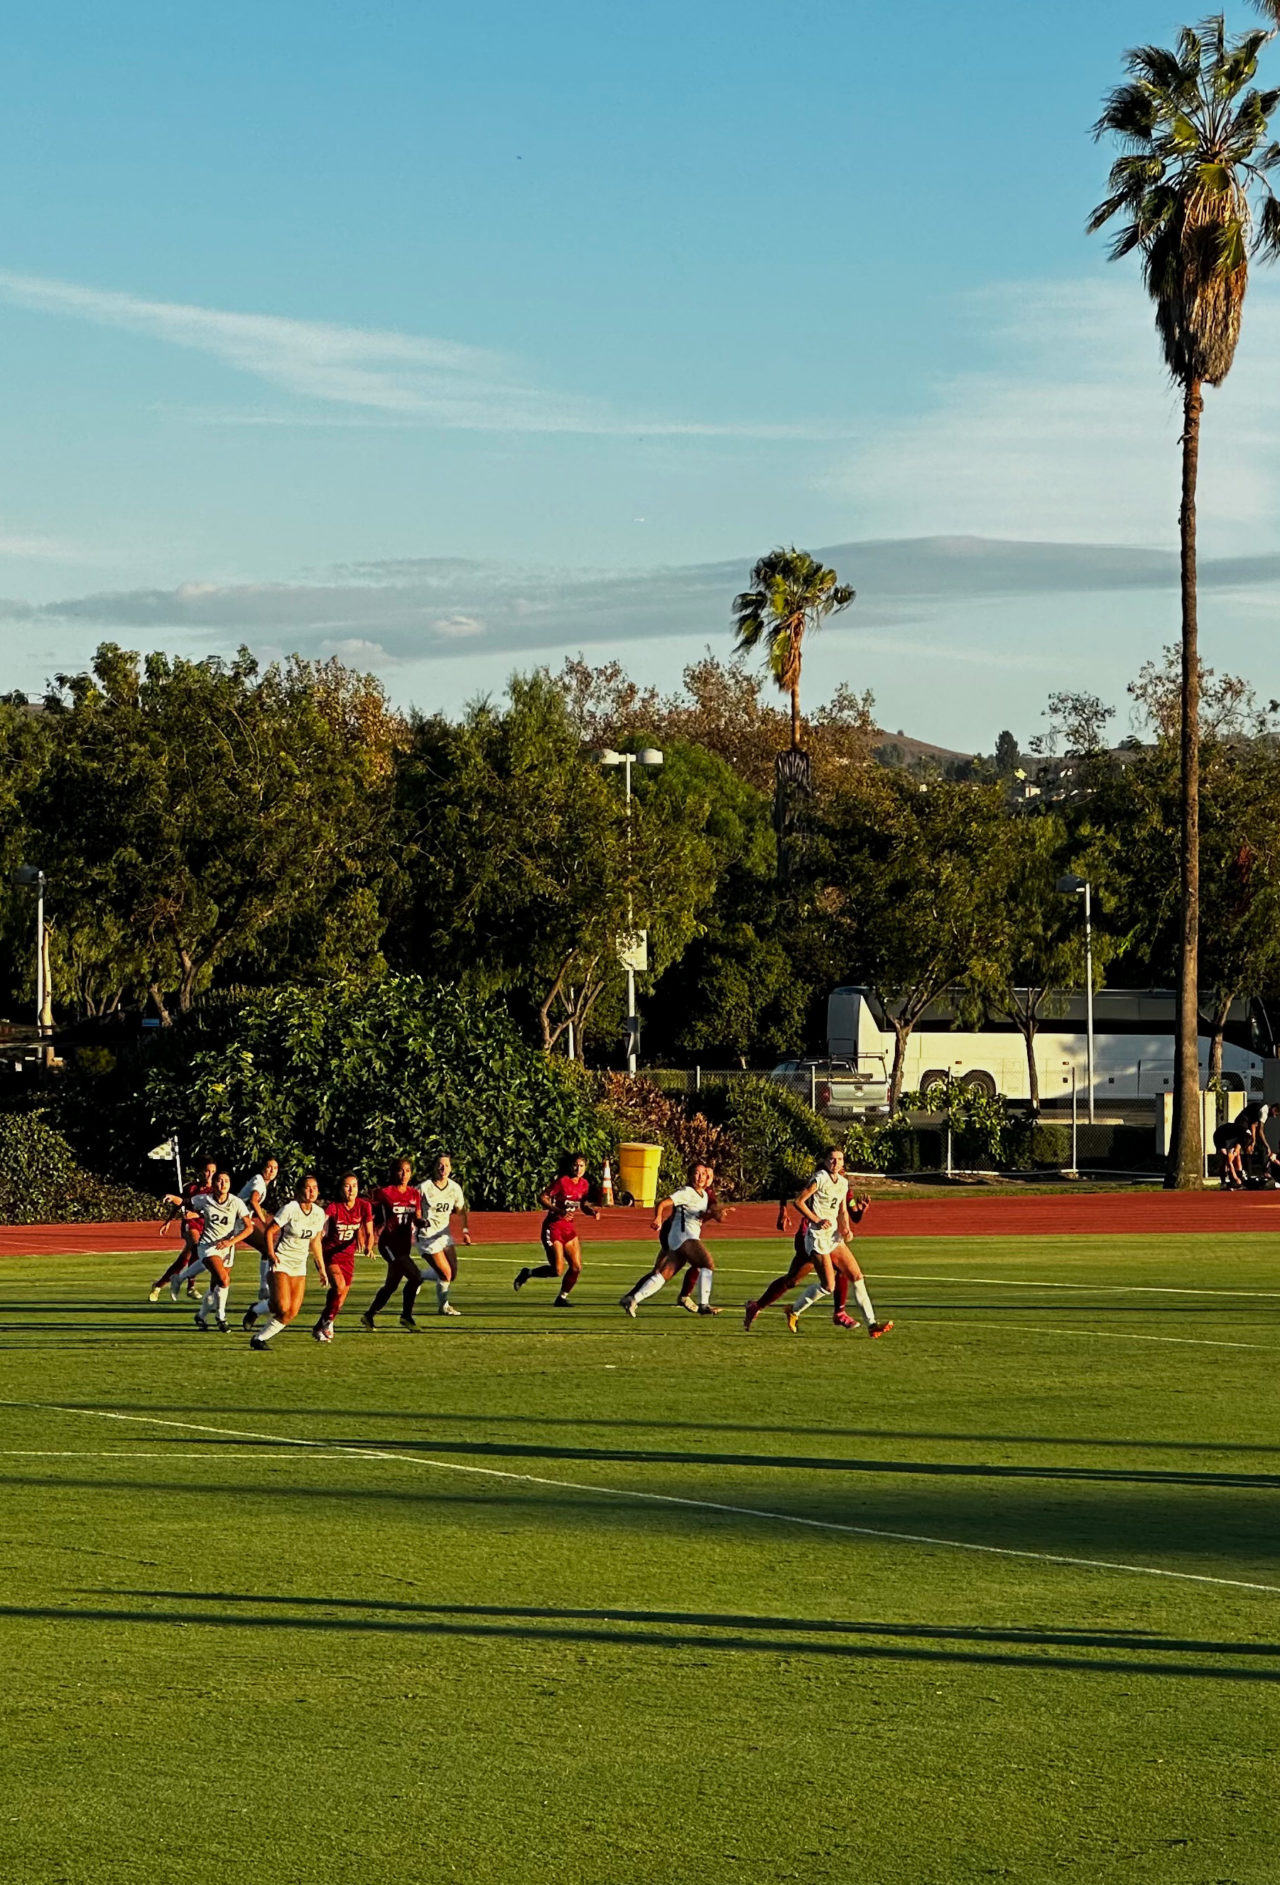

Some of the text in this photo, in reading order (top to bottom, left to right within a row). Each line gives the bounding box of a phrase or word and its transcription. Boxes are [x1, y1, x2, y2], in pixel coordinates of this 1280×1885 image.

[435, 1202, 450, 1213] 20
[829, 1197, 838, 1209] 2
[210, 1213, 229, 1226] 24
[338, 1229, 355, 1241] 19
